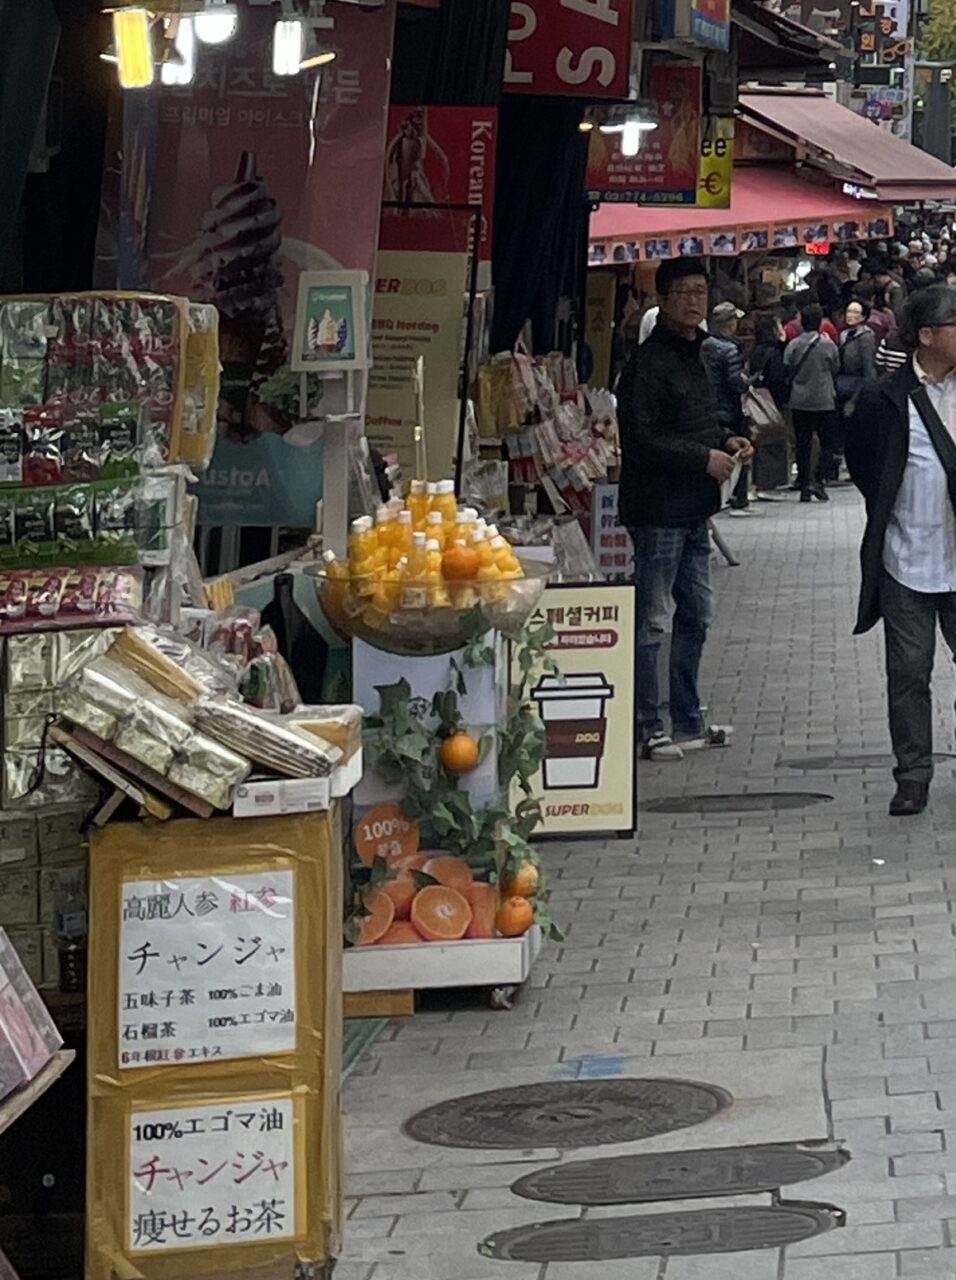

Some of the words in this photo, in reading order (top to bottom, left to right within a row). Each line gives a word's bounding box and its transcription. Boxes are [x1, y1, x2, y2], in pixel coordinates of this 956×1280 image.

[468, 121, 492, 205] Korean
[530, 605, 620, 626] 스페셜커피
[363, 818, 410, 841] 100%
[128, 936, 286, 975] チャンジャ
[123, 989, 196, 1010] 五味子茶
[208, 982, 282, 1000] 100%ごま油
[208, 1009, 294, 1028] 100%エゴマ油
[133, 1107, 284, 1142] 100%エゴマ油
[134, 1151, 288, 1191] チャンジャ
[133, 1199, 286, 1247] 痩せるお茶
